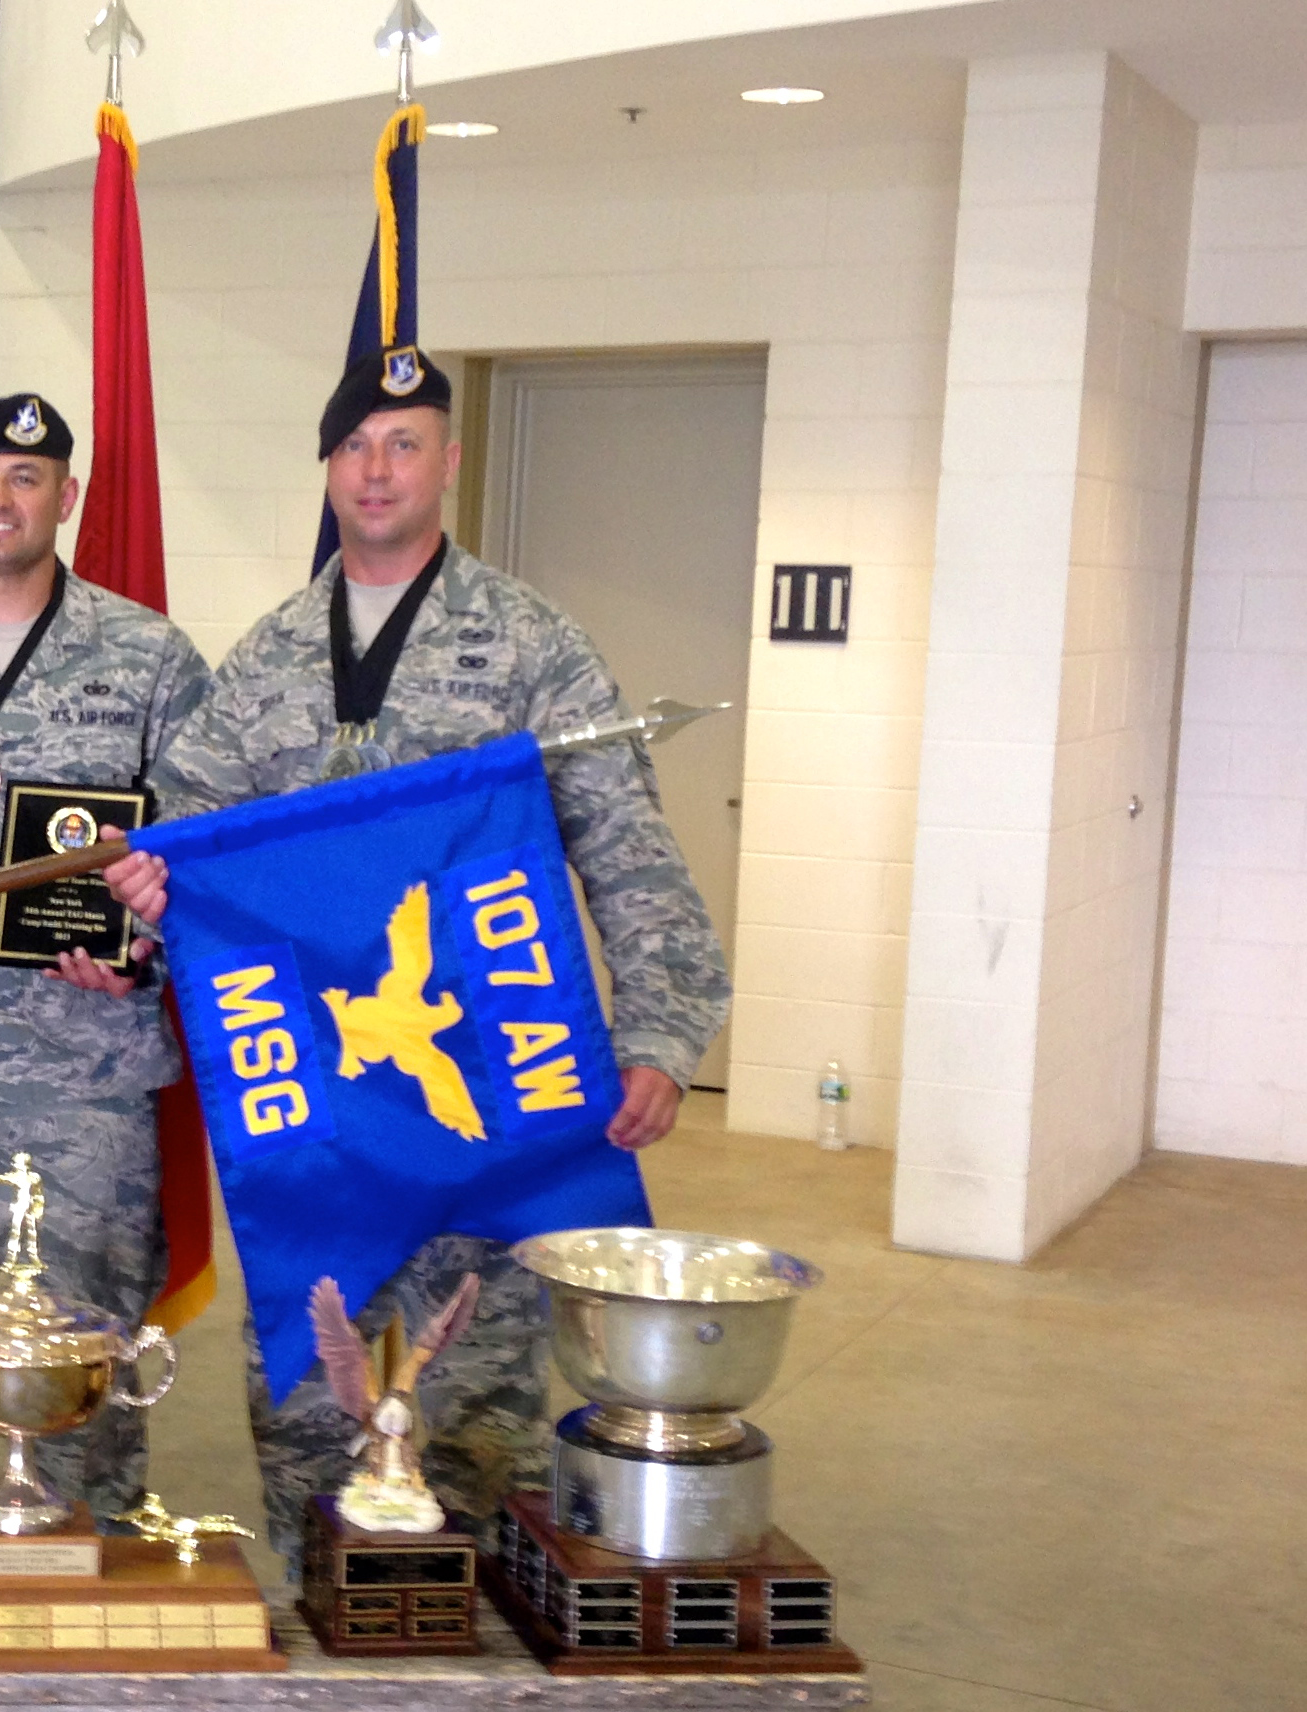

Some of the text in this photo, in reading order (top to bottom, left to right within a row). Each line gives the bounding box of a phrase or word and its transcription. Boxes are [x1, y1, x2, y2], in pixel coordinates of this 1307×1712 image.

[466, 869, 555, 987] 107
[210, 964, 310, 1136] MSG
[499, 1021, 586, 1113] AW
